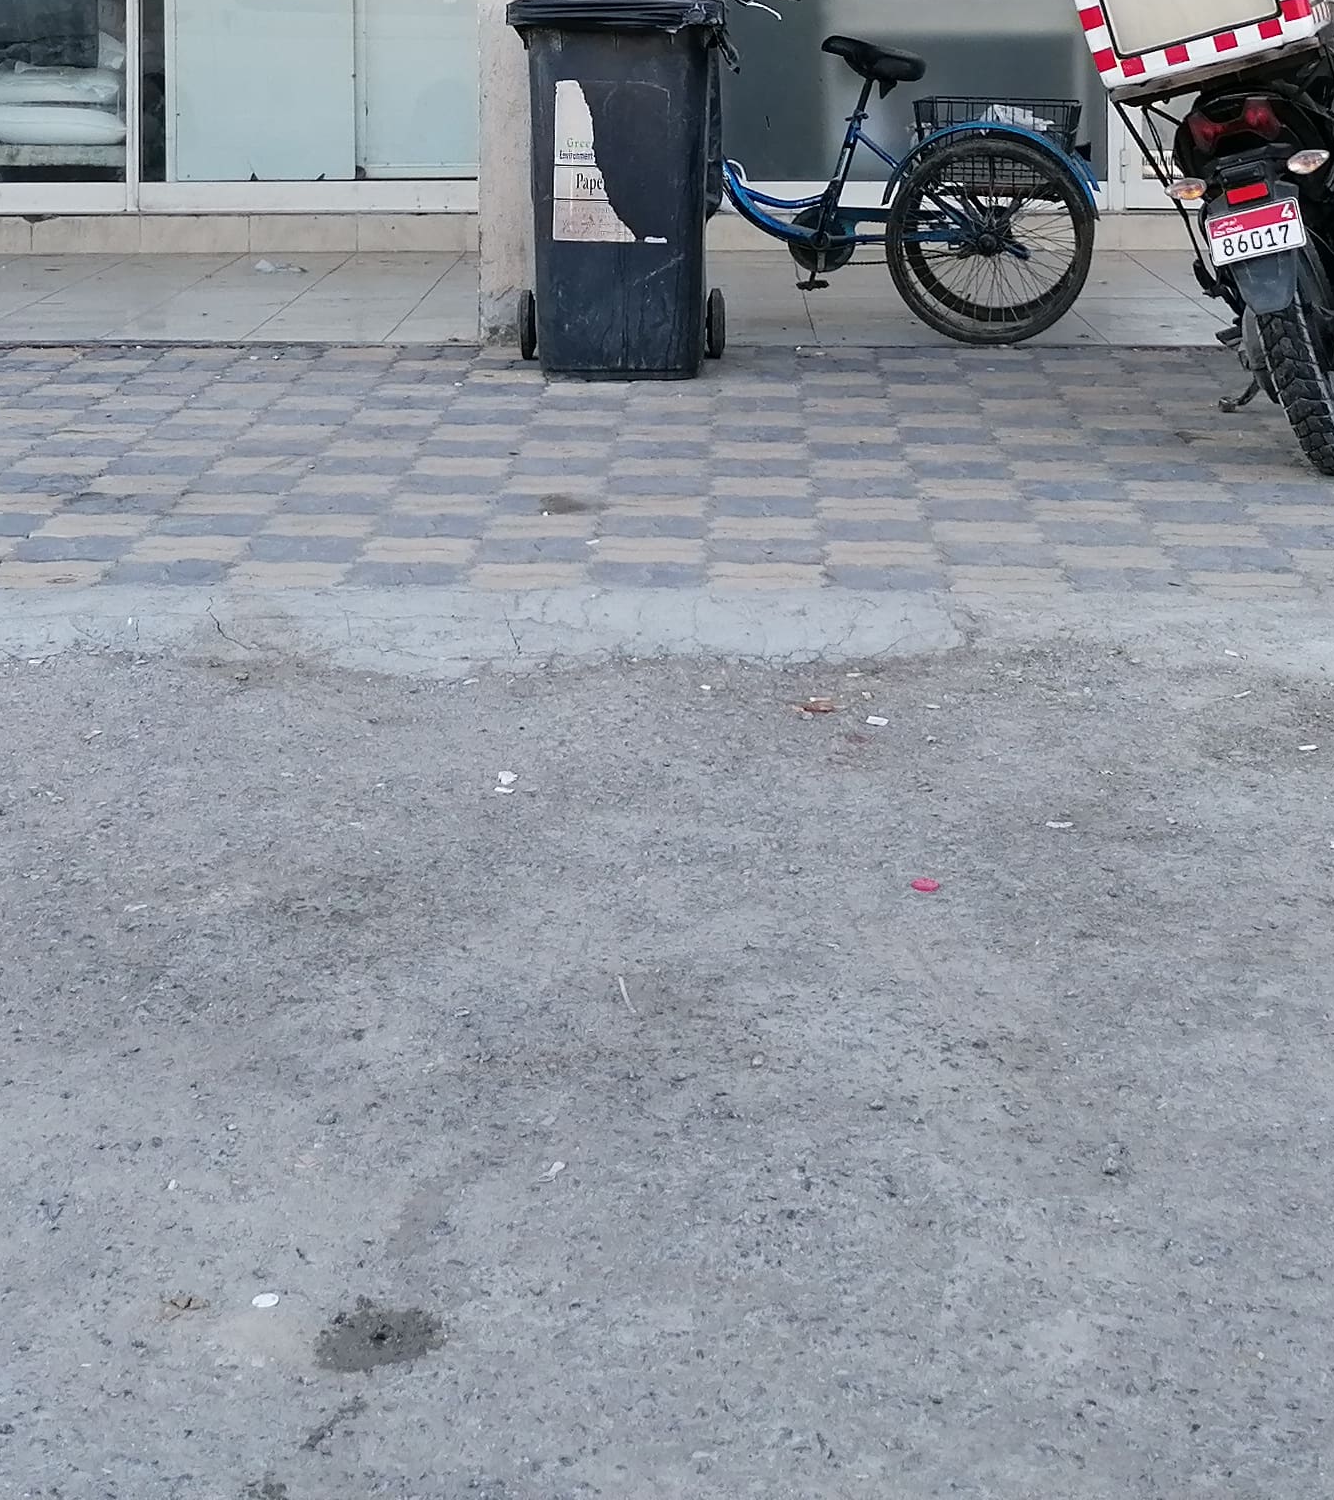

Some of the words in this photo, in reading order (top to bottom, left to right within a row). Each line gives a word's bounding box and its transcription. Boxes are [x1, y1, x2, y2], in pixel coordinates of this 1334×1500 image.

[576, 173, 604, 195] Pape
[1280, 203, 1294, 219] 4
[1223, 224, 1289, 256] 86017
